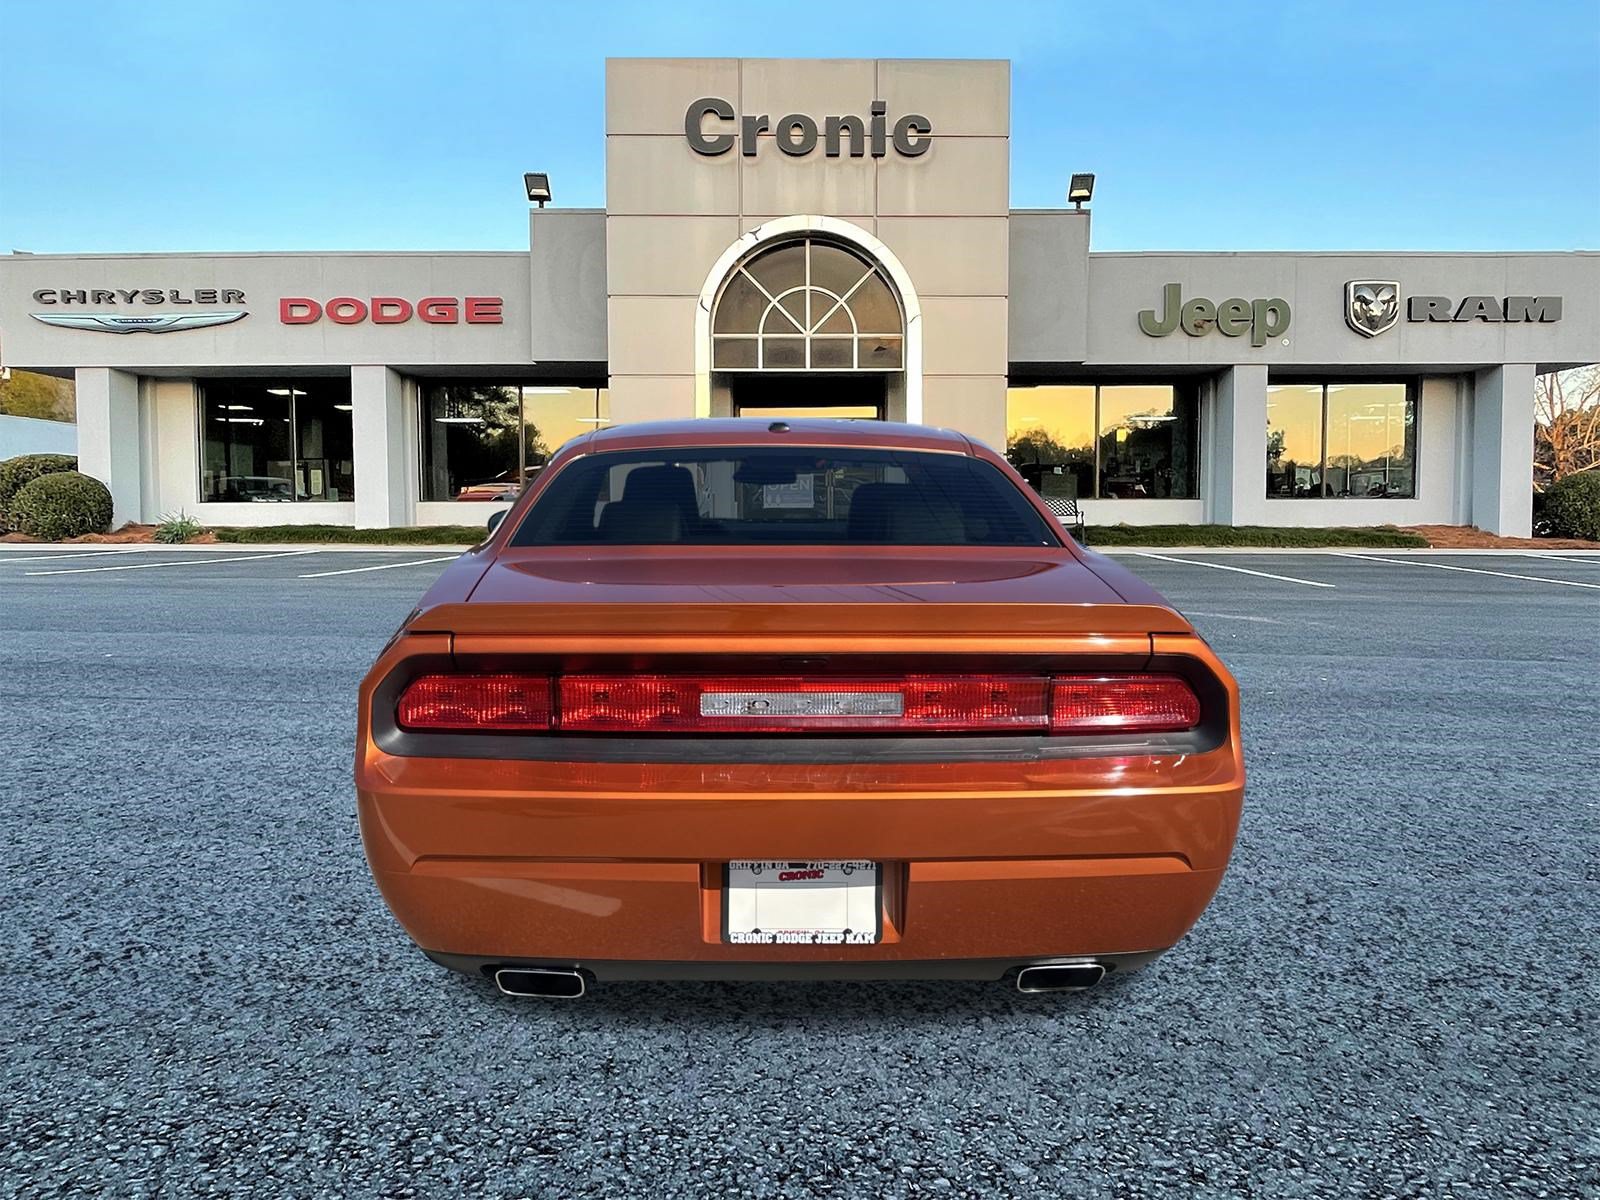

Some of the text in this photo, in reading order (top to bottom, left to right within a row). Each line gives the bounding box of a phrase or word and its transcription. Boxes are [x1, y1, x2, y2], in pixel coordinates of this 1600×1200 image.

[685, 97, 932, 158] Cronic
[32, 289, 247, 305] CHRYSLER
[1407, 296, 1563, 322] RAM
[279, 297, 504, 324] DODGE
[1138, 283, 1292, 347] Jeep
[778, 869, 824, 881] CRONIC
[730, 932, 773, 944] CRONIC
[776, 932, 813, 944] DODGE
[815, 932, 844, 944] JEEP
[846, 932, 876, 944] RAM
